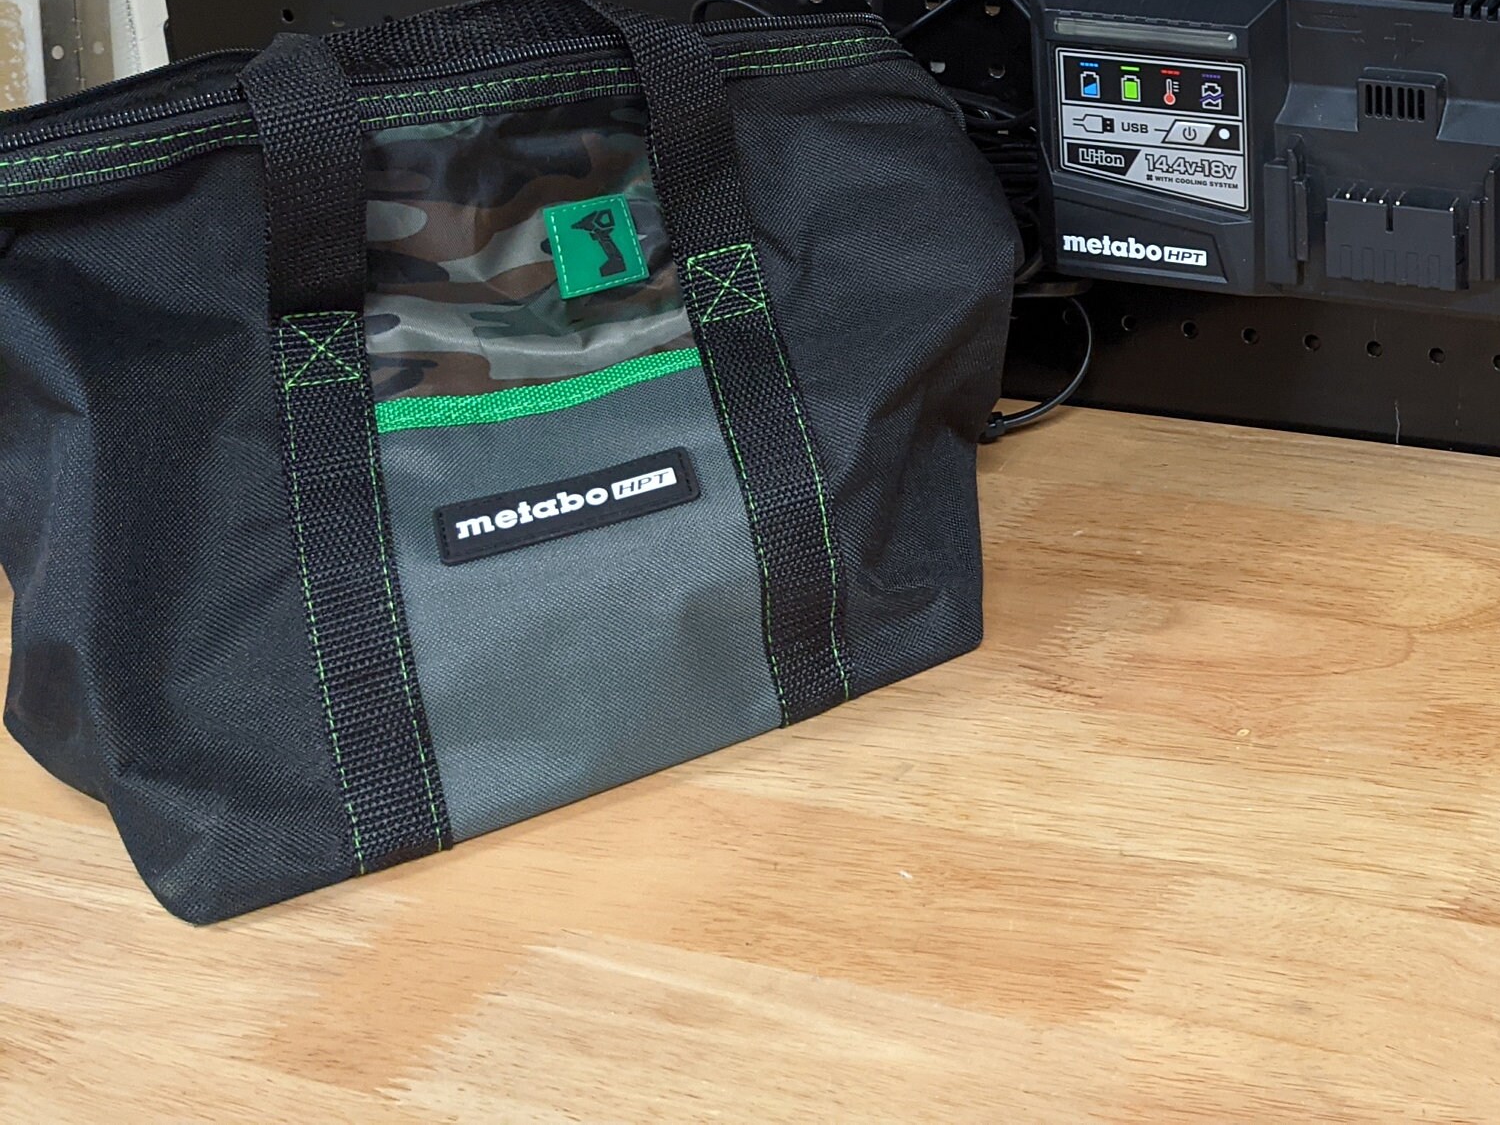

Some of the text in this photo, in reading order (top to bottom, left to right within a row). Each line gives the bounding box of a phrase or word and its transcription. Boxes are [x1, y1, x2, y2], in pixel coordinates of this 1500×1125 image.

[1122, 121, 1149, 134] USB
[1079, 148, 1124, 167] Li-ion
[1155, 176, 1239, 189] WITH COOLING SYSTEM
[1063, 235, 1205, 264] metabo HPT
[456, 470, 675, 539] metabo HPT
